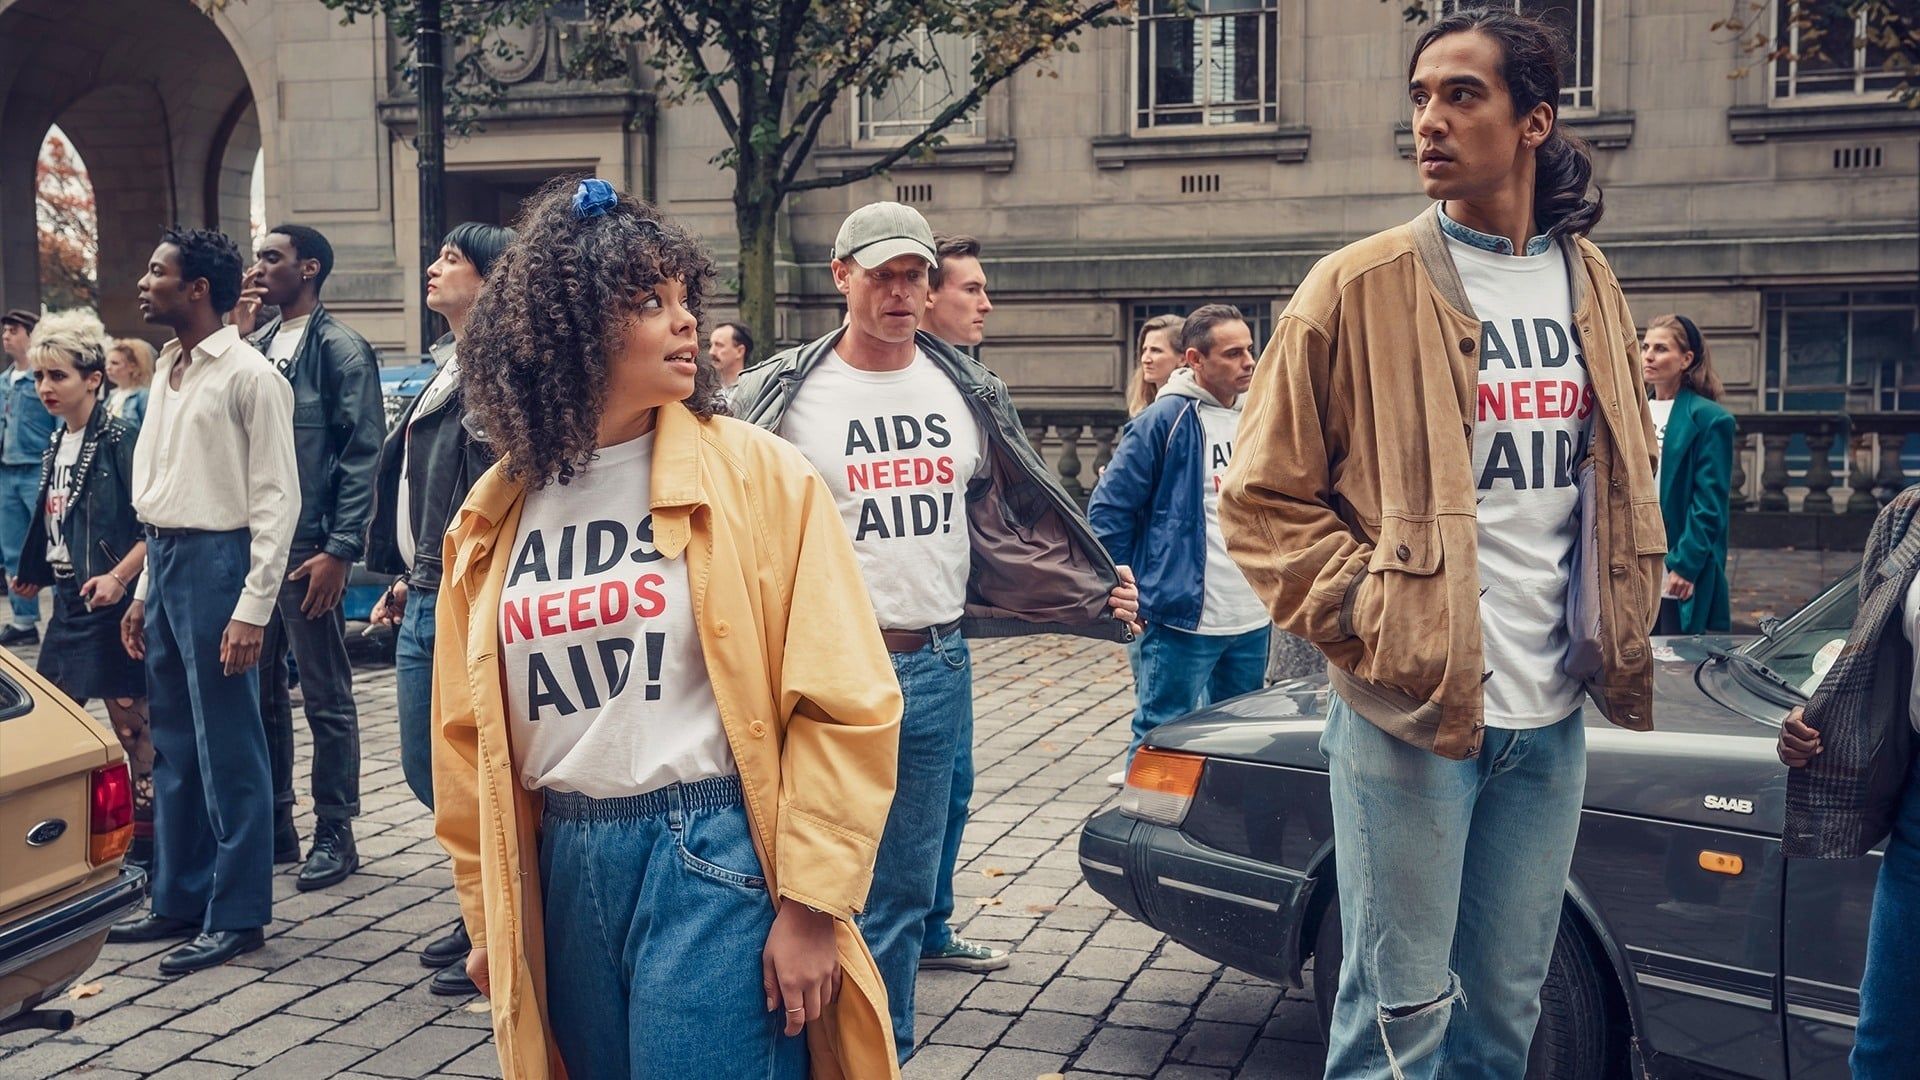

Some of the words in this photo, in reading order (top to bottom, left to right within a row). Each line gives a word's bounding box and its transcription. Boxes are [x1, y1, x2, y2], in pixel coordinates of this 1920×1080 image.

[1478, 380, 1594, 422] NEEDS
[845, 413, 952, 456] AIDS
[847, 456, 955, 492] NEEDS
[856, 492, 954, 541] AID!
[503, 573, 666, 644] NEEDS
[528, 632, 666, 722] AID!
[1703, 794, 1754, 814] SAAB
